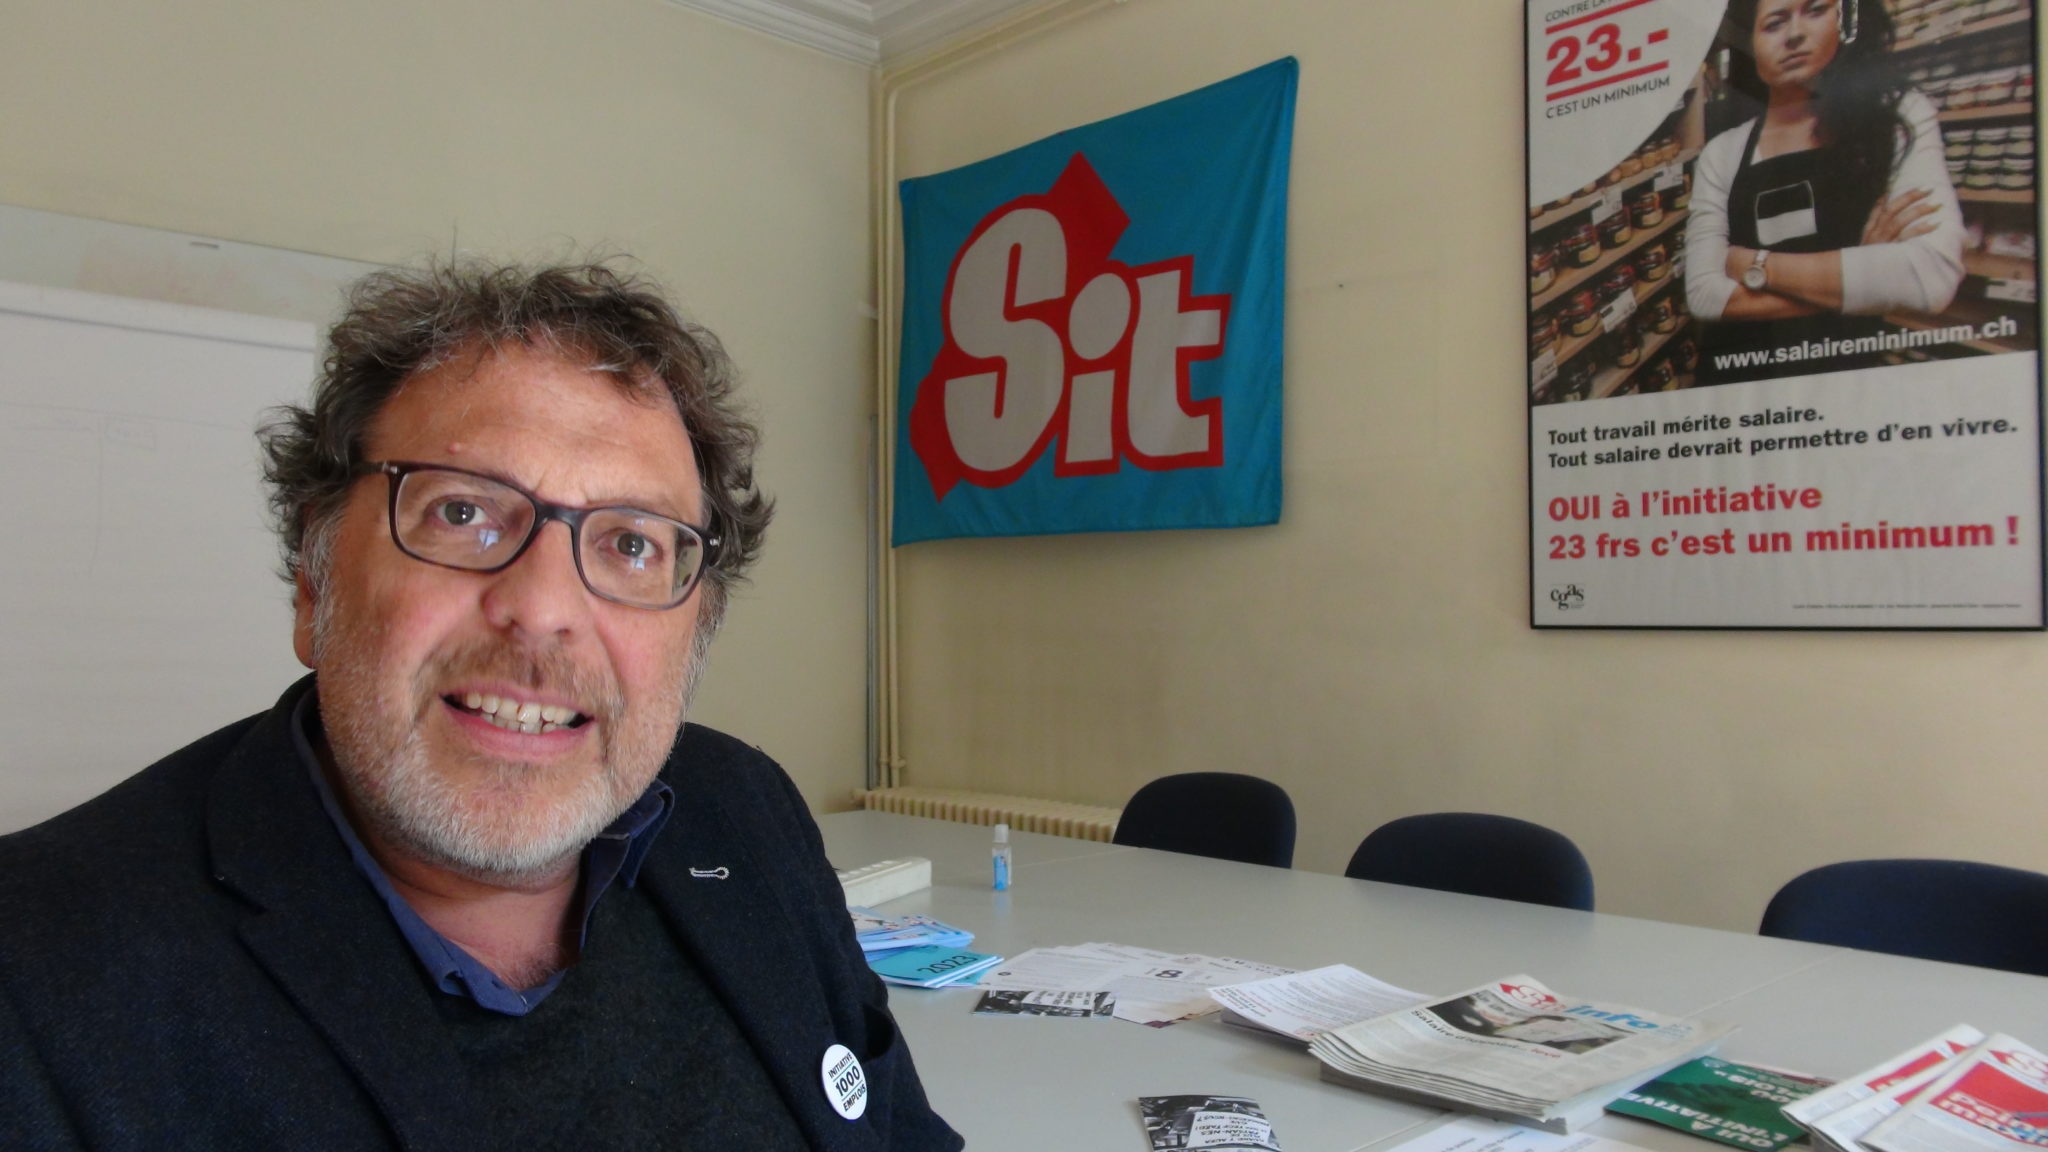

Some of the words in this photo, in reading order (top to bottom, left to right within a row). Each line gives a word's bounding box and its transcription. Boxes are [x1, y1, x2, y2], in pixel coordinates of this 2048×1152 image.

[1581, 95, 1601, 110] UN
[1604, 75, 1670, 103] MINIMUM
[943, 207, 1222, 472] Sit
[1714, 315, 2017, 370] www.salaireminimum.ch
[1548, 427, 1588, 446] Tout
[1594, 420, 1656, 440] travail
[1663, 415, 1732, 435] mérite
[1739, 406, 1825, 428] salaire.
[1548, 451, 1588, 469] Tout
[1594, 447, 1661, 466] salaire
[1668, 437, 1743, 460] devrait
[1750, 429, 1868, 457] permettre
[1877, 424, 1932, 443] d'en
[1942, 418, 2018, 437] vivre.
[1548, 495, 1601, 522] OUI
[1612, 492, 1631, 519] à
[1641, 482, 1823, 518] l'initiative
[1549, 534, 1586, 561] 23
[1596, 532, 1641, 559] frs
[1651, 529, 1736, 557] c'est
[1749, 531, 1792, 554] un
[1806, 521, 1995, 552] minimum
[2006, 515, 2019, 546] !
[917, 955, 978, 974] 2023
[1565, 1004, 1660, 1030] info
[828, 1052, 853, 1079] INITIATIVE
[835, 1065, 861, 1097] 1000
[843, 1083, 866, 1112] EMPLOIS
